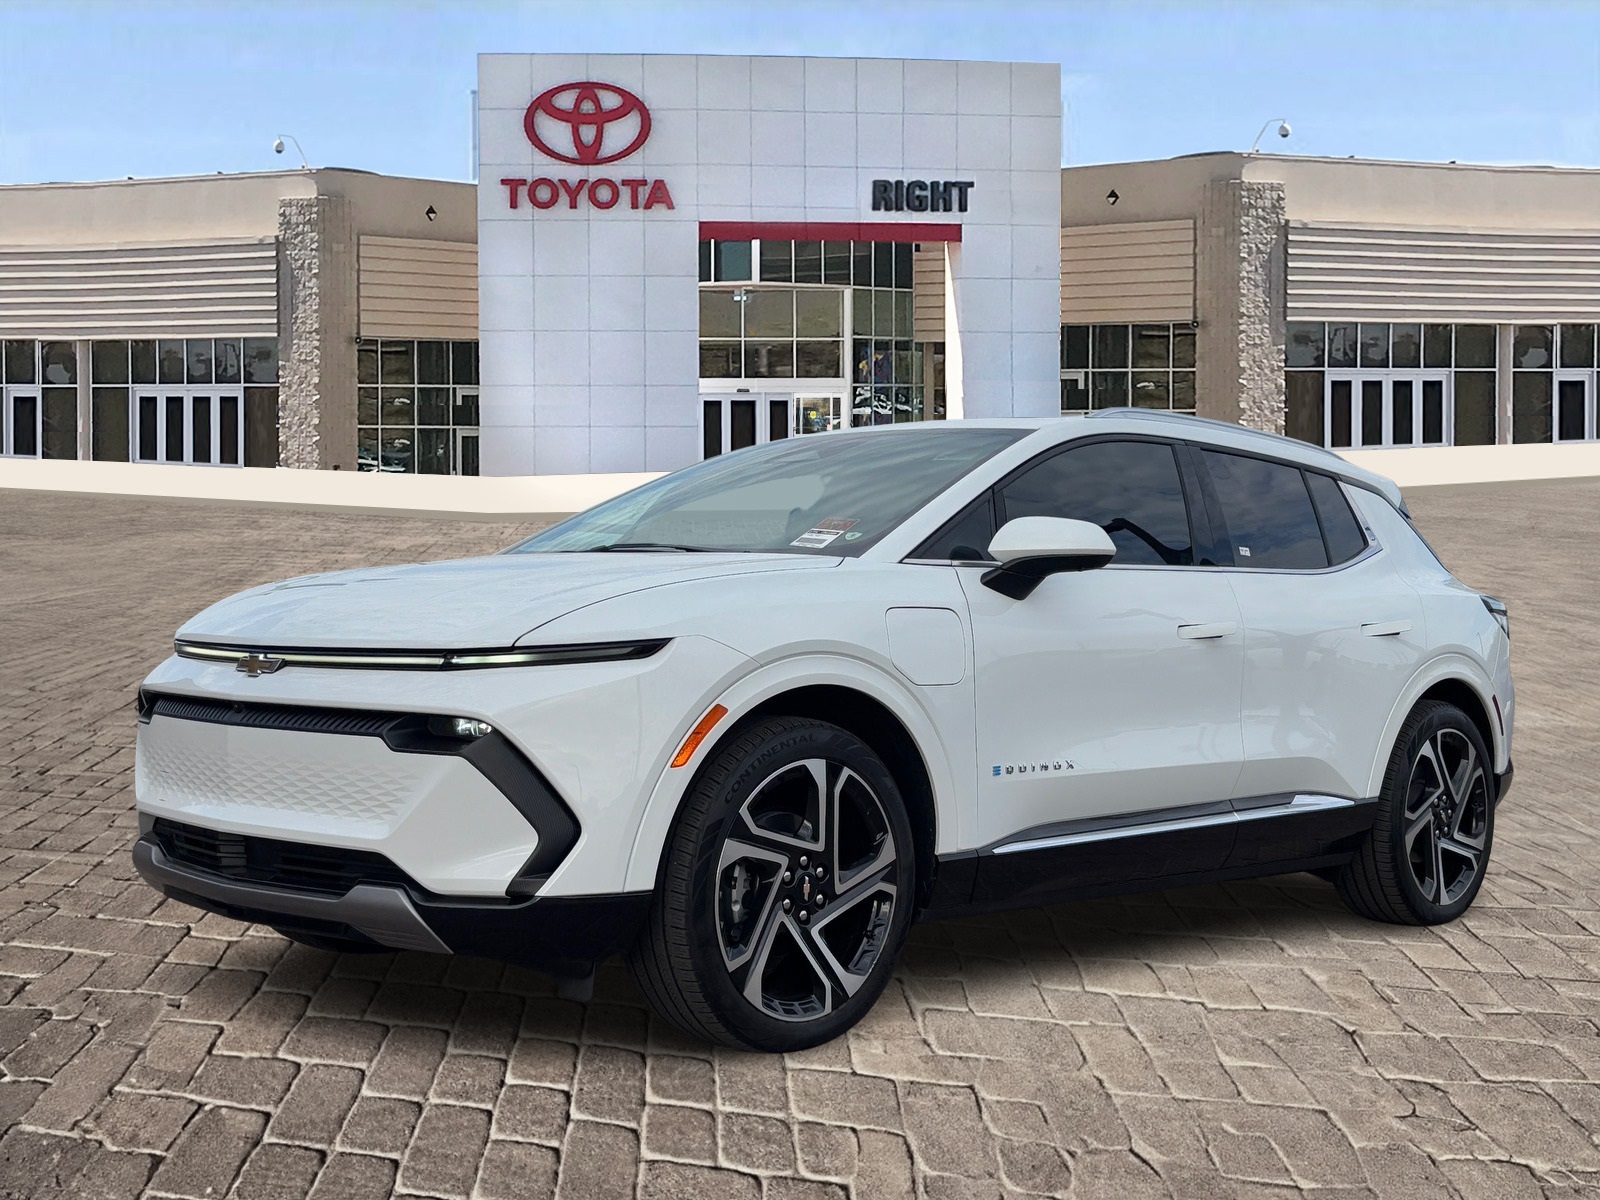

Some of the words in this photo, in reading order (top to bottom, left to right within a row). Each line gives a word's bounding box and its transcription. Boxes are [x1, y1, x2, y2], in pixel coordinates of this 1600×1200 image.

[500, 178, 675, 210] TOYOTA
[871, 179, 974, 213] RIGHT
[724, 733, 818, 804] CONTINENTAL
[992, 759, 1075, 777] EQUINOX
